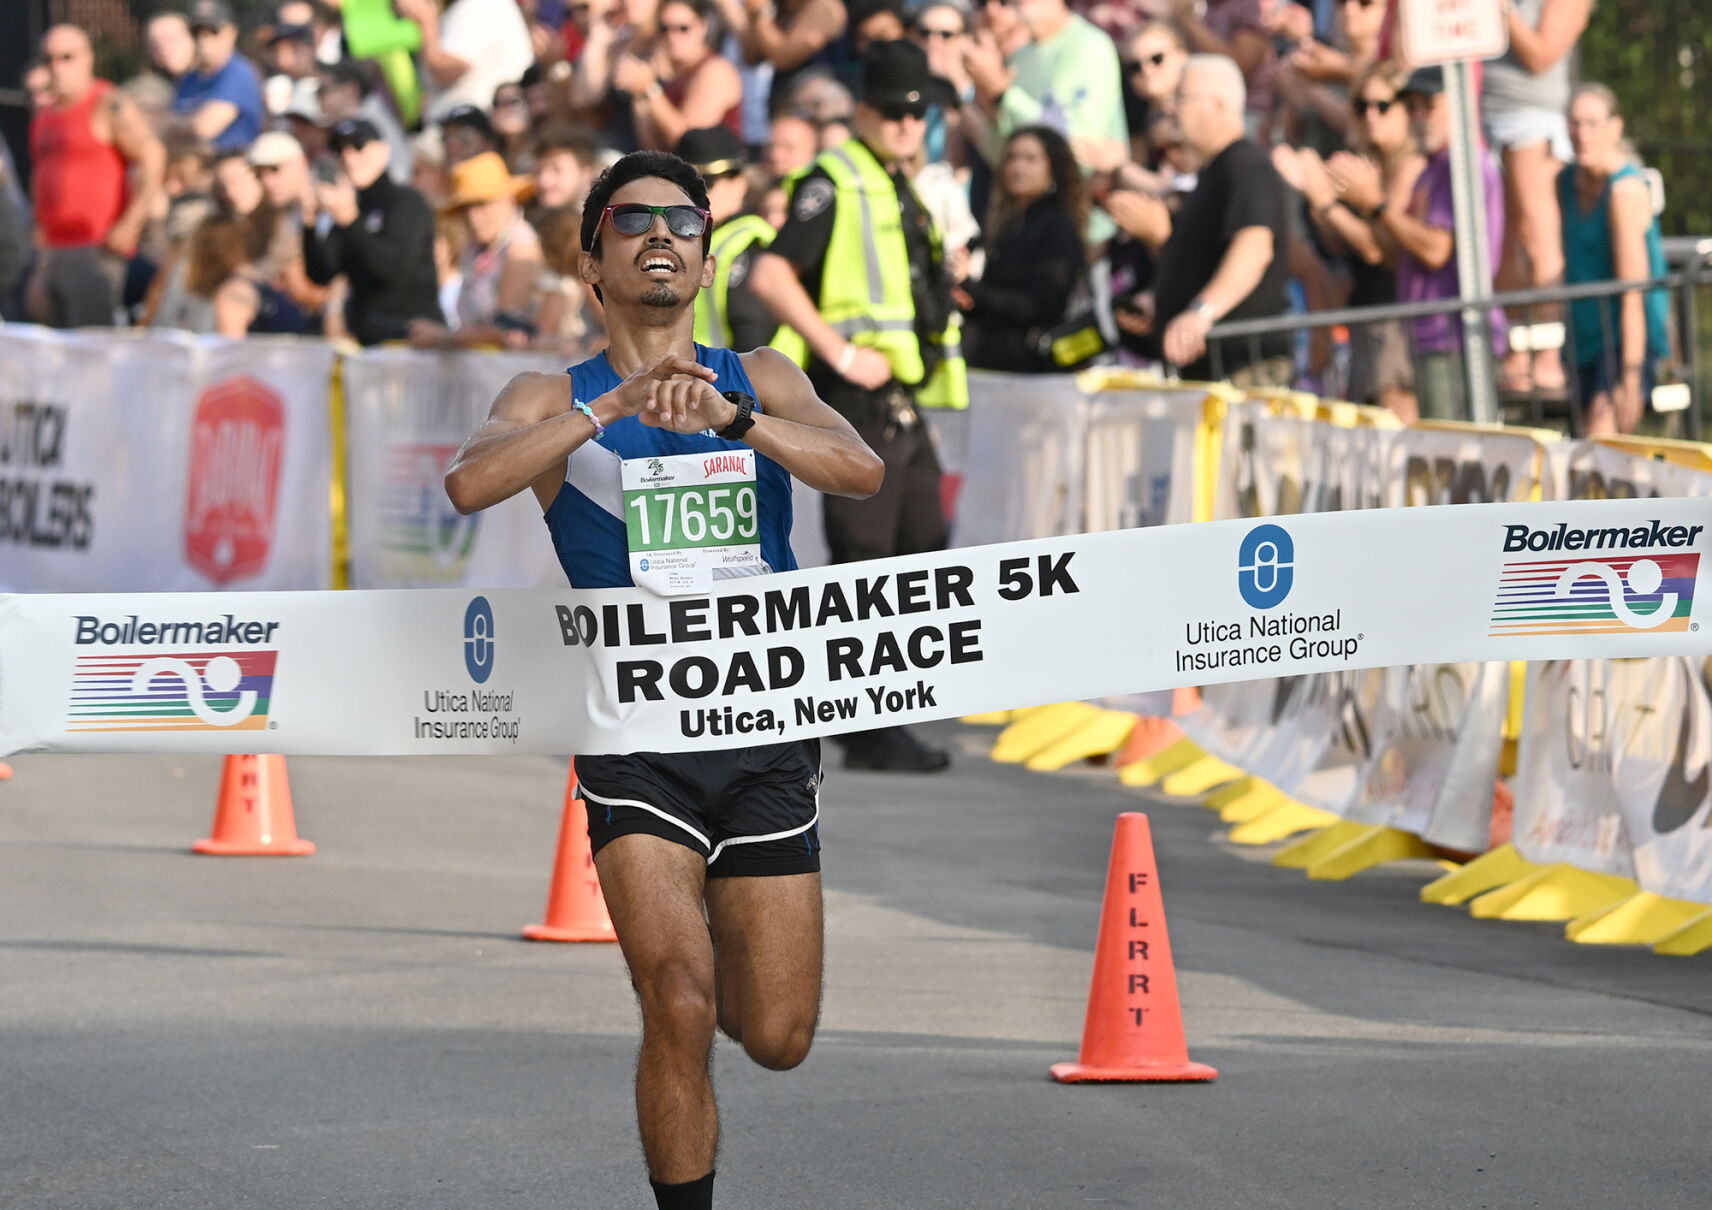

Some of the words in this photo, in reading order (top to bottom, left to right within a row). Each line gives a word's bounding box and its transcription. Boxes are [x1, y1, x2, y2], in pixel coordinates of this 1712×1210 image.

[640, 475, 675, 483] Boilermaker
[703, 455, 748, 478] SARANAC
[630, 487, 758, 545] 17659
[1501, 519, 1704, 552] Boilermaker
[555, 565, 975, 648] BOILERMAKER
[997, 552, 1080, 602] 5K
[71, 615, 280, 645] Boilermaker
[1186, 620, 1242, 645] Utica
[1250, 608, 1341, 638] National
[616, 645, 806, 704] ROAD
[826, 619, 984, 682] RACE
[1176, 645, 1282, 672] Insurance
[424, 690, 468, 713] Utica
[471, 689, 514, 712] National
[680, 702, 786, 738] Utica,
[794, 695, 859, 726] New
[869, 680, 938, 716] York
[414, 716, 488, 739] Insurance
